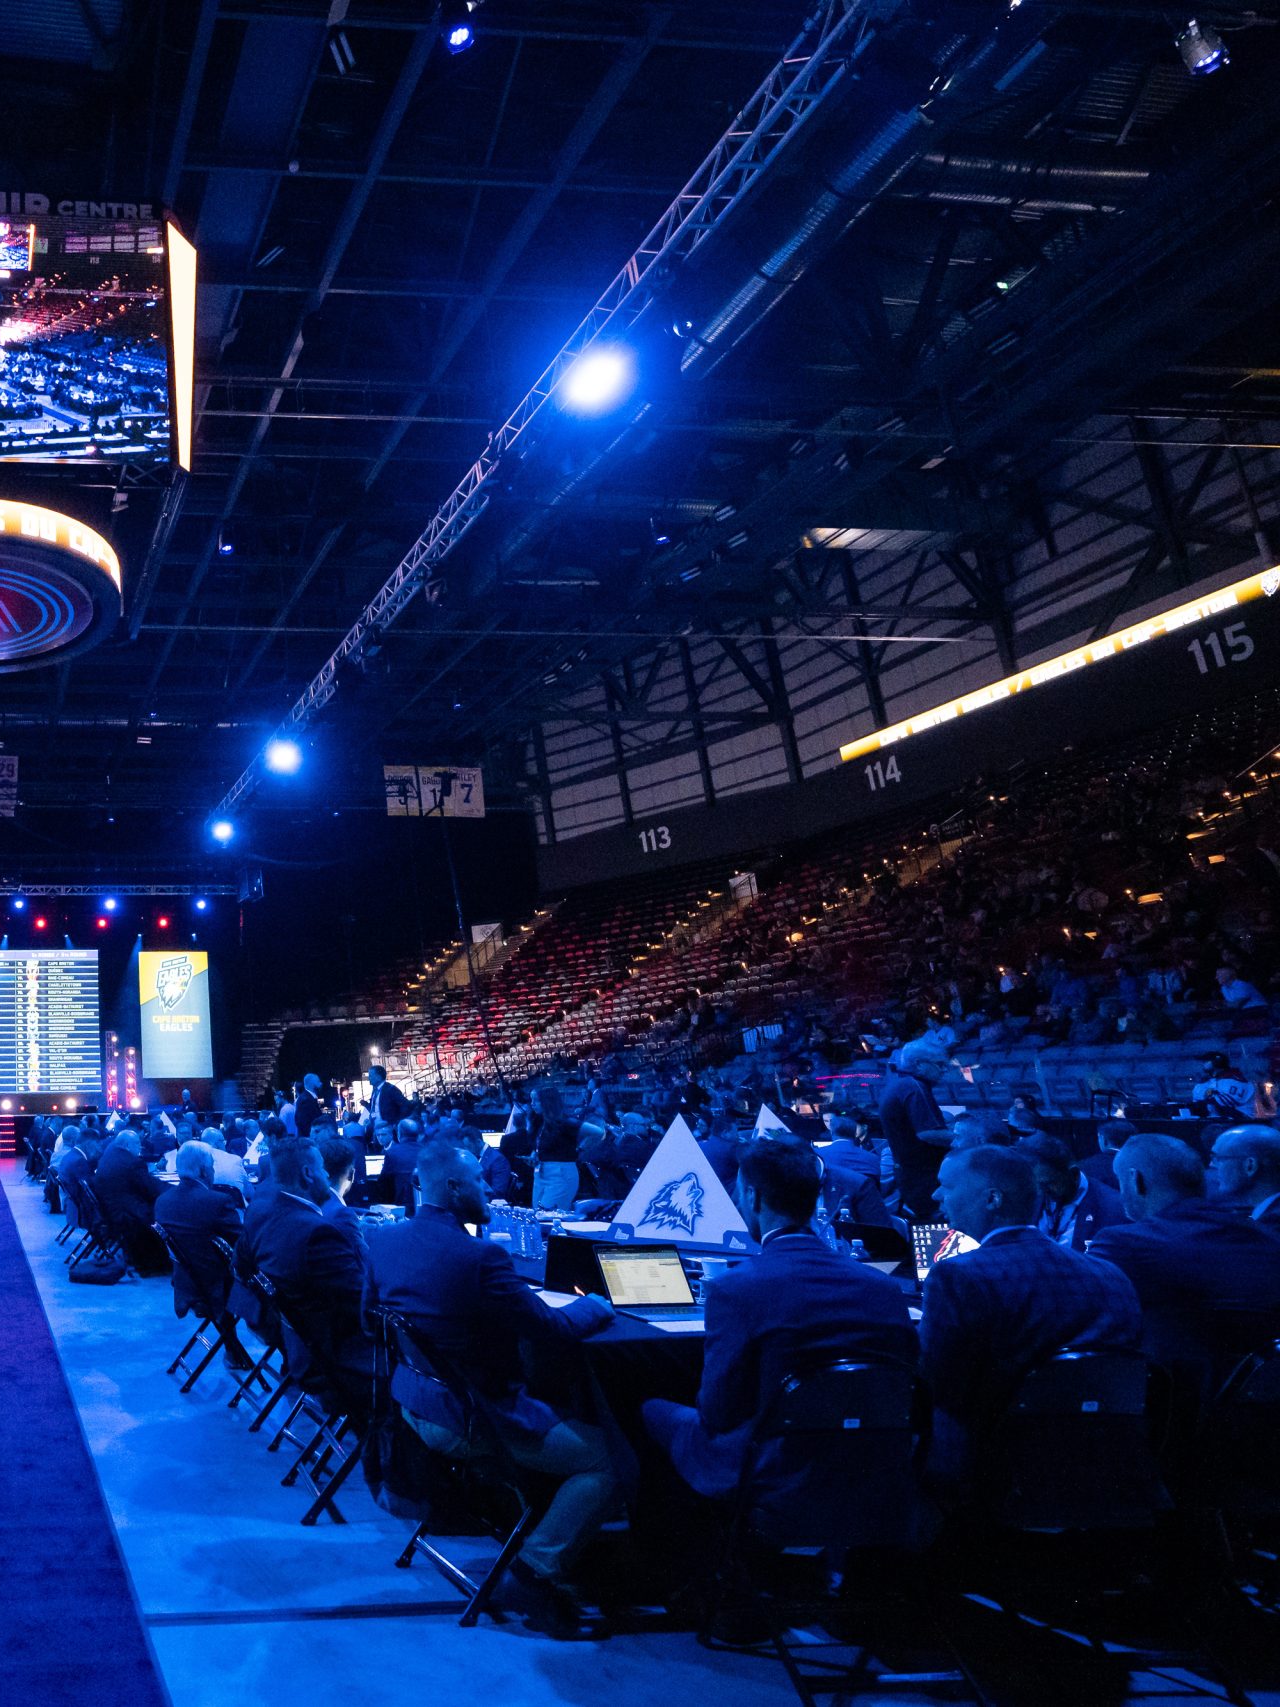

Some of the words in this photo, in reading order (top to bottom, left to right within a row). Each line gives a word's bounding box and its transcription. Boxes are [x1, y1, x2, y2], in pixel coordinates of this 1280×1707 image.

[57, 200, 153, 220] CENTRE
[19, 510, 58, 543] DU
[1187, 621, 1255, 674] 115
[864, 755, 902, 791] 114
[460, 783, 473, 804] 7
[638, 826, 673, 854] 113
[160, 1023, 193, 1032] EAGLES
